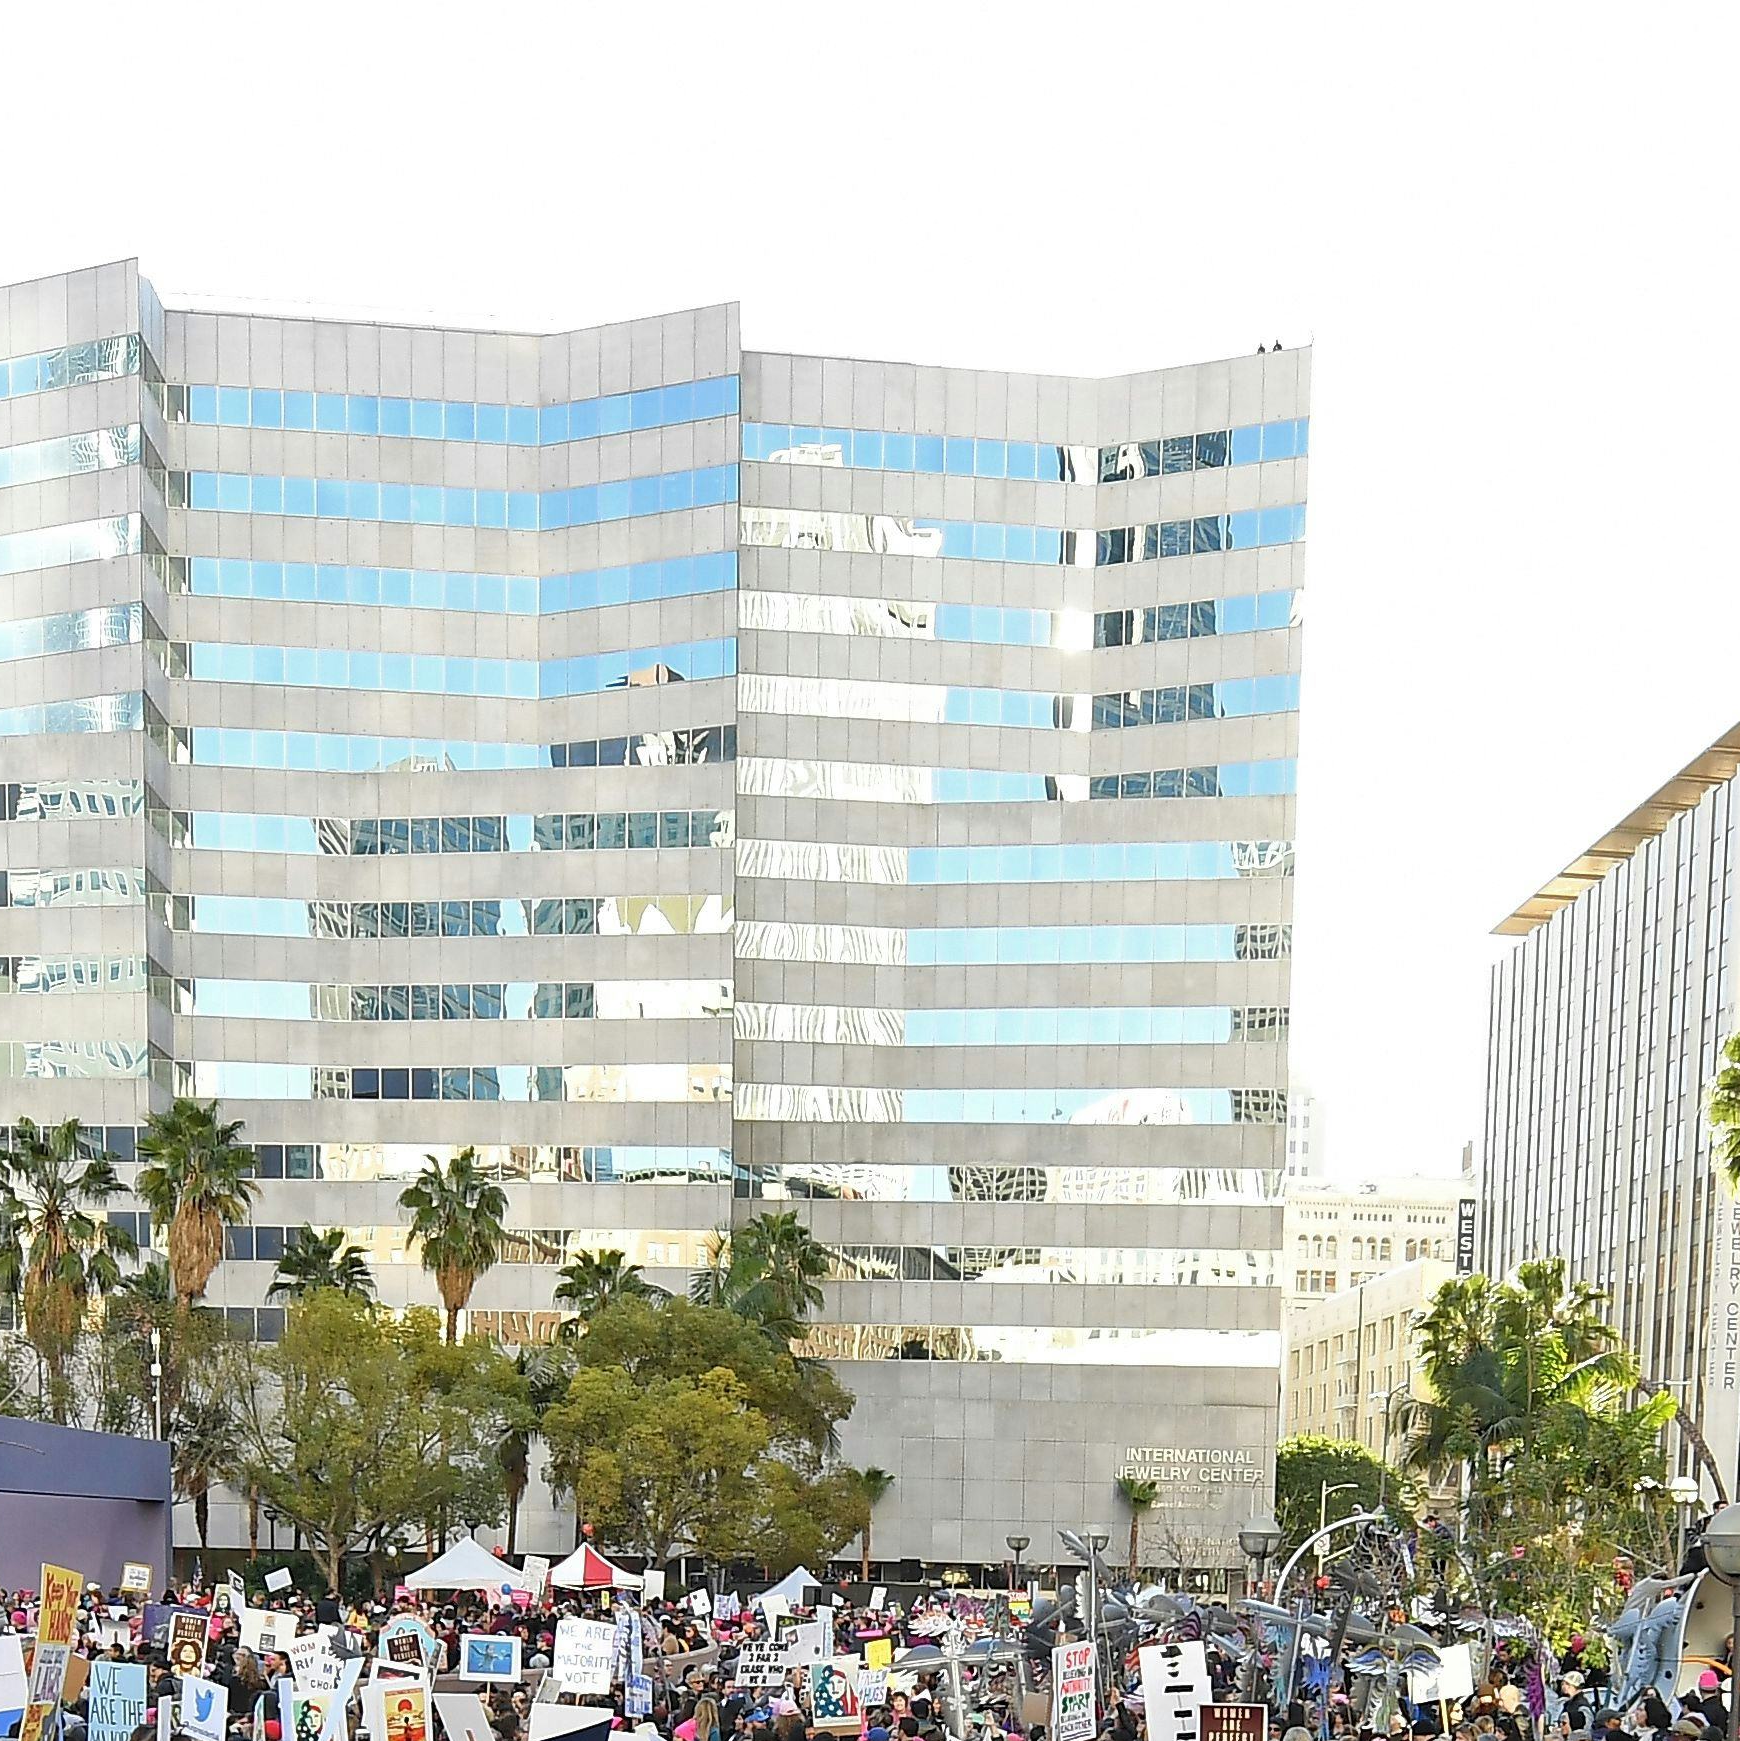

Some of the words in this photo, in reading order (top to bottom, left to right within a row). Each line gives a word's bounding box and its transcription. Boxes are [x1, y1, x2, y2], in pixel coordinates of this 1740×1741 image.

[1723, 1302, 1740, 1390] CENTER
[1125, 1447, 1255, 1464] INTERNATIONAL
[1115, 1465, 1191, 1481] JEWELRY
[1199, 1467, 1264, 1483] CENTER
[560, 1625, 576, 1638] WE
[585, 1626, 611, 1641] ARE
[556, 1655, 612, 1670] MAJORITY
[1065, 1647, 1091, 1669] STOP
[95, 1665, 122, 1696] WE
[564, 1671, 600, 1684] VOTE
[91, 1698, 117, 1725] ARE
[120, 1699, 144, 1726] THE
[1061, 1693, 1091, 1714] START
